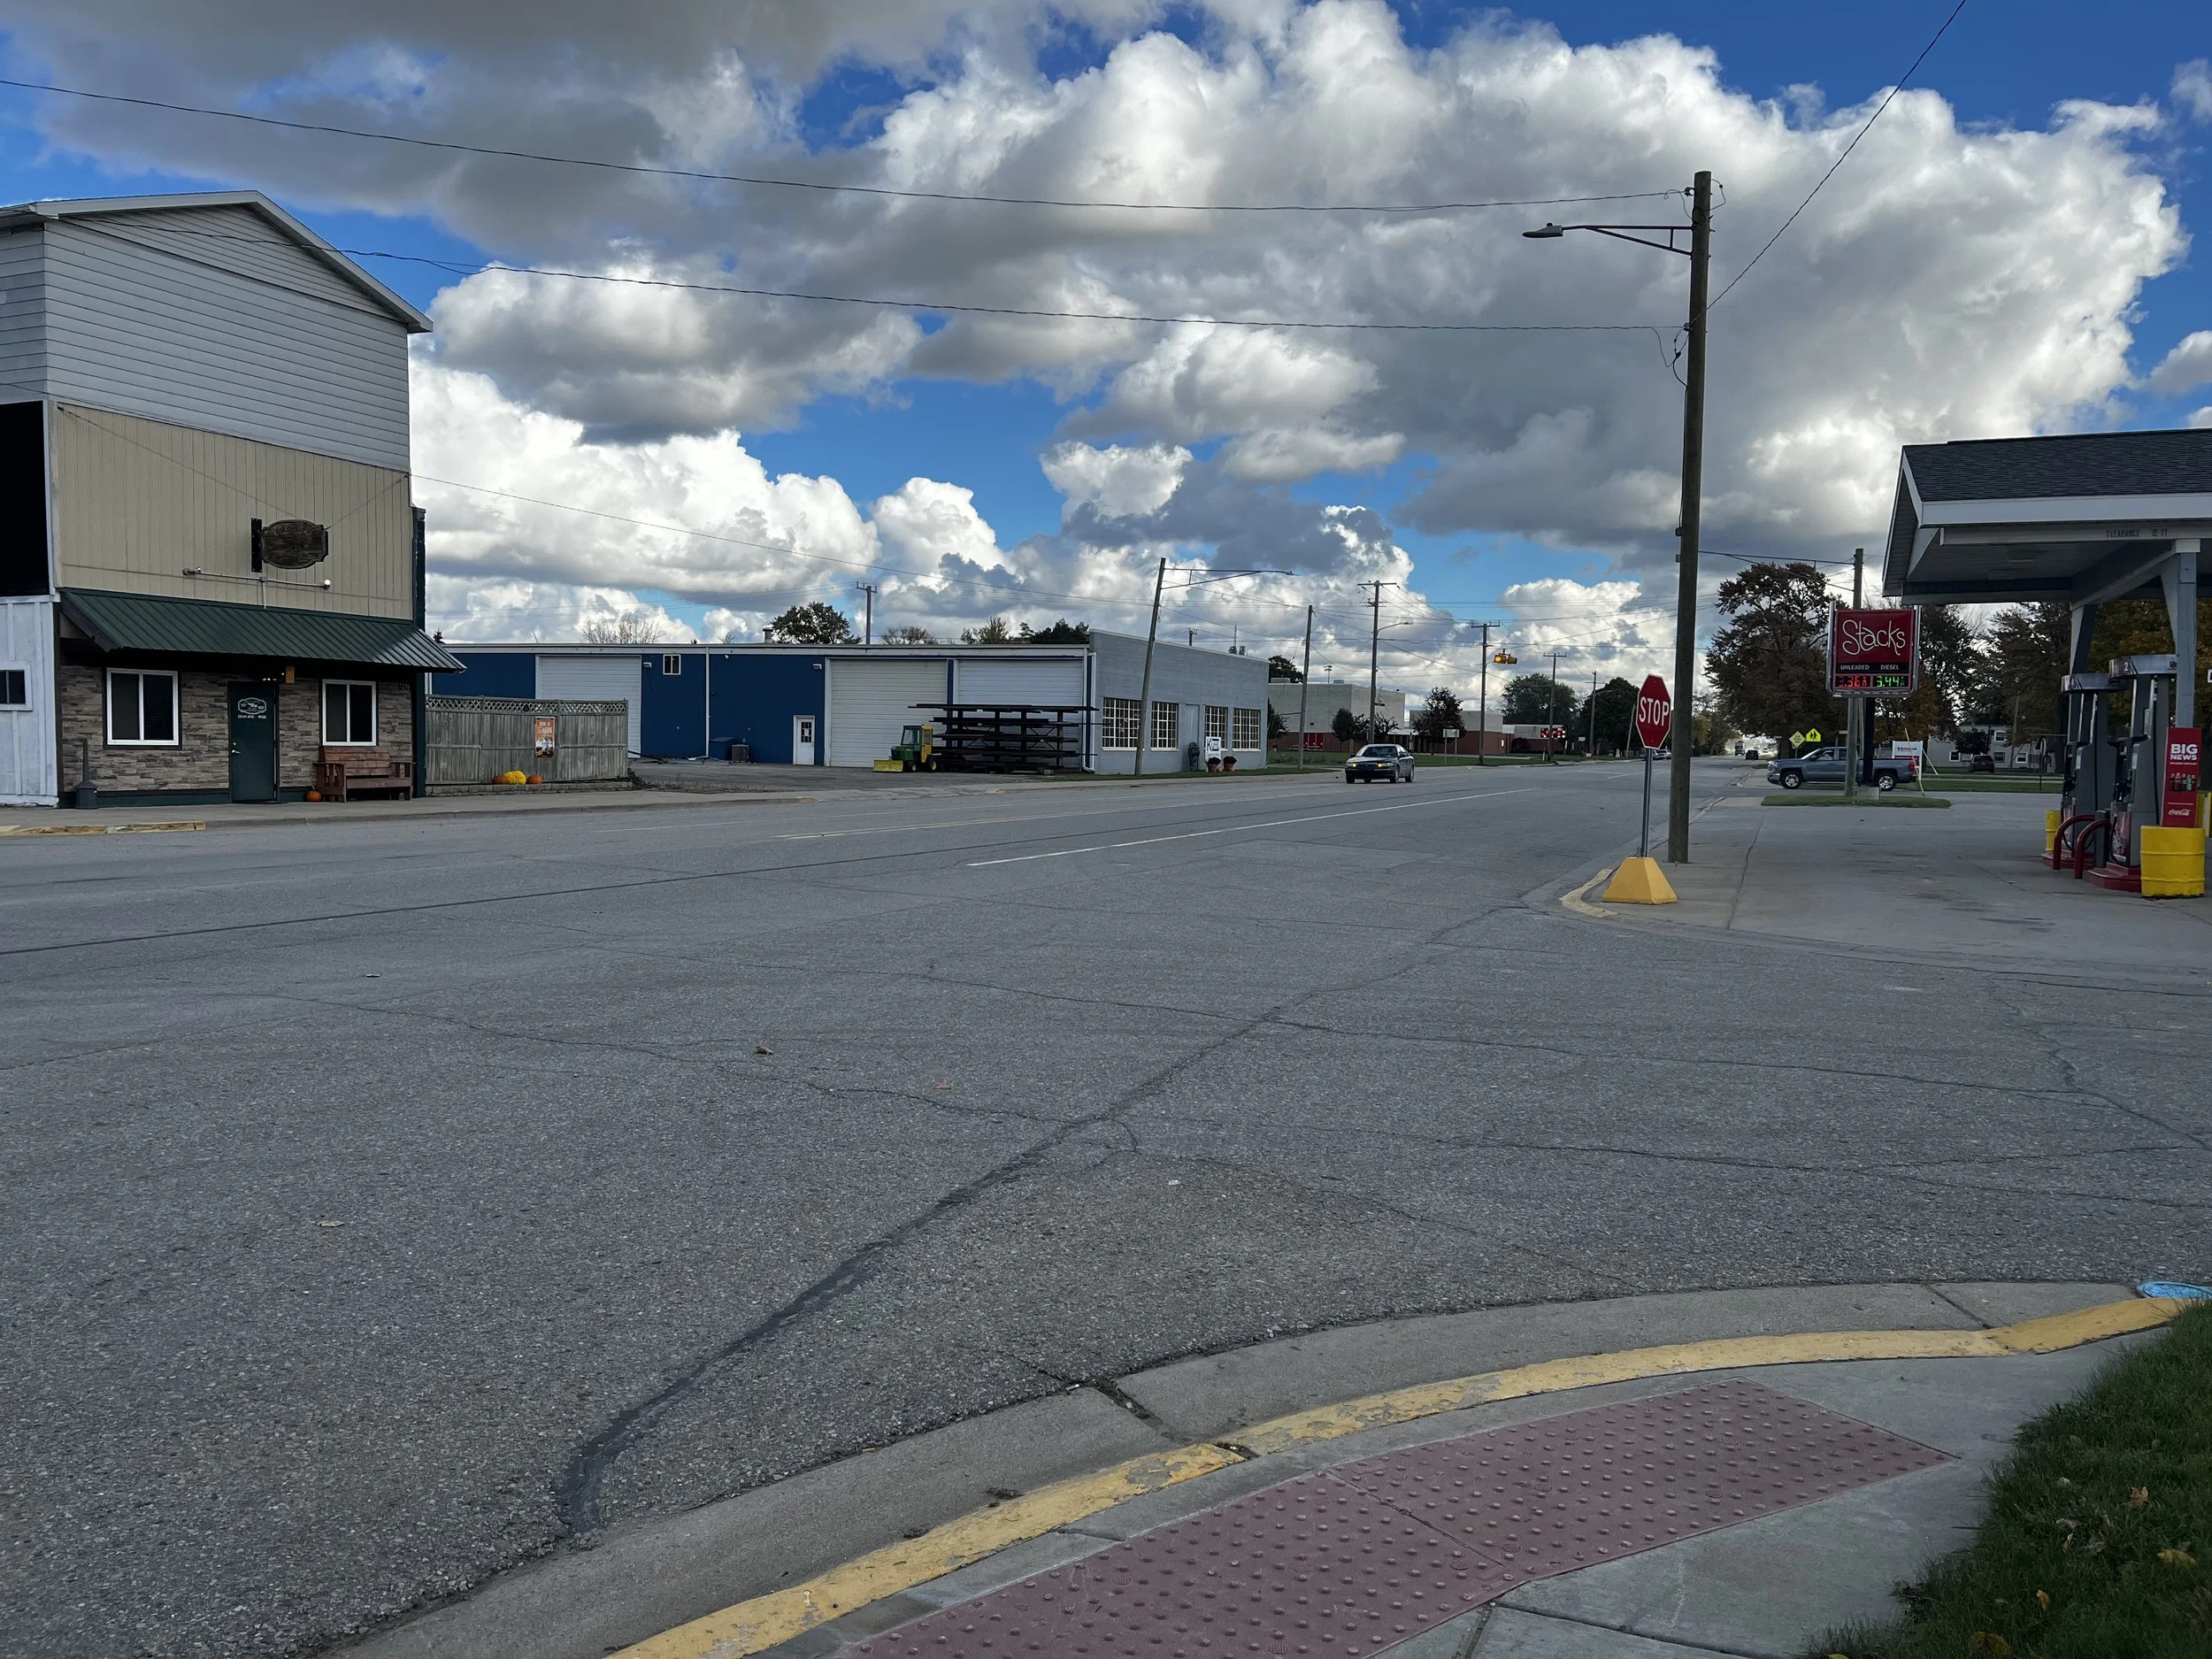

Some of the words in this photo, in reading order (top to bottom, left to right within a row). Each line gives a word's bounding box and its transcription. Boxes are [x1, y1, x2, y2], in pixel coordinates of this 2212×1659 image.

[1842, 619, 1906, 657] Stacks
[1639, 696, 1670, 726] STOP
[2170, 743, 2199, 755] BIG
